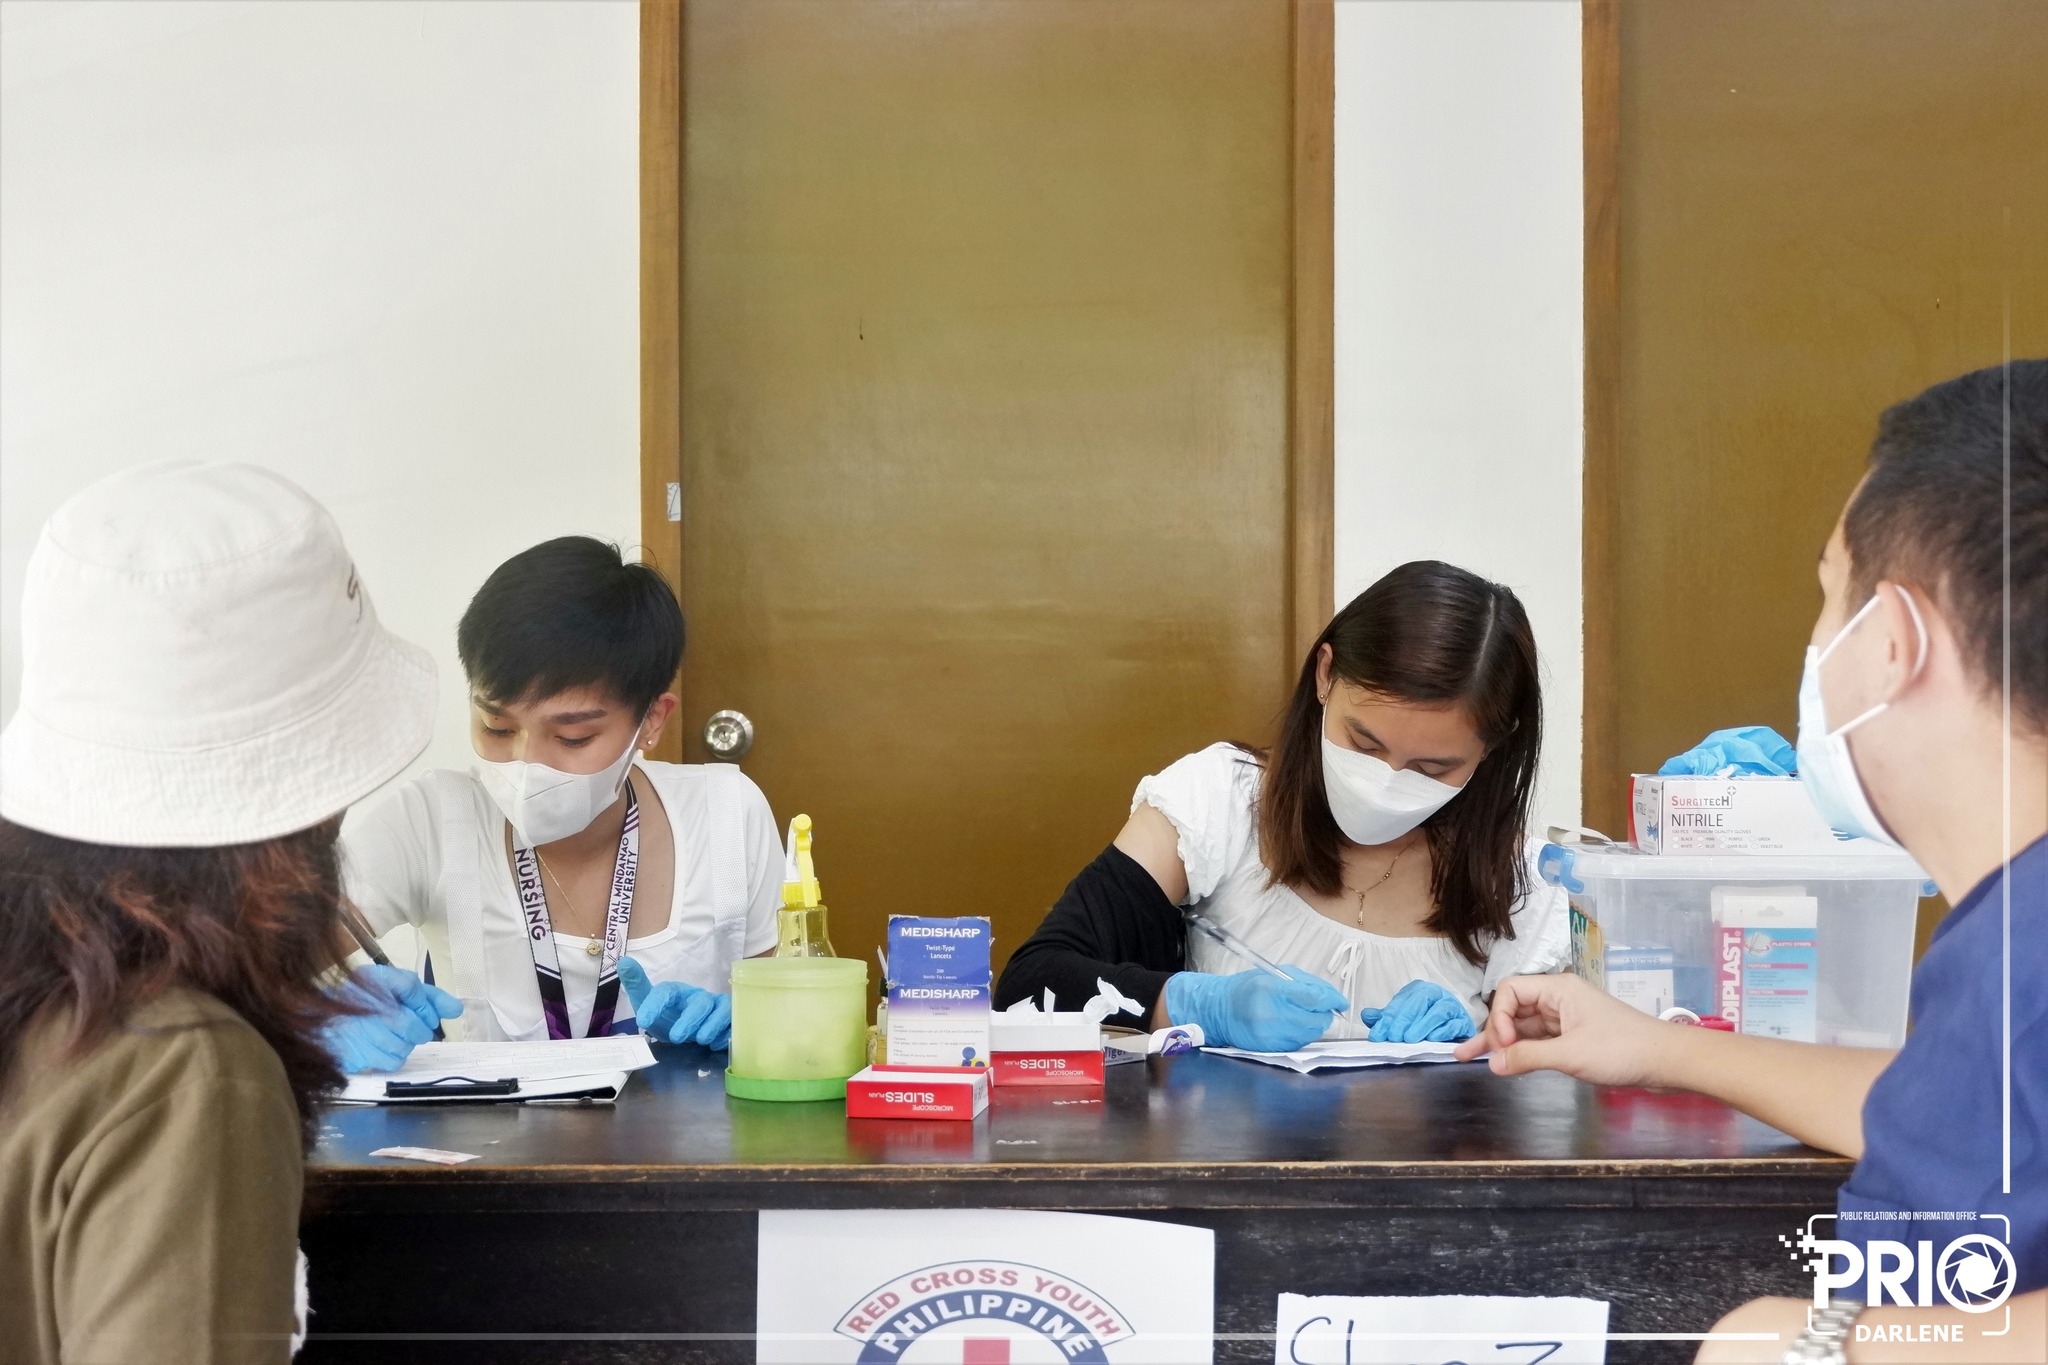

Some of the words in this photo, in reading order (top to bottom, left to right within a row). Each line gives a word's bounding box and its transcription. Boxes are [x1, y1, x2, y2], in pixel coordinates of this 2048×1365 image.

[1671, 795, 1730, 807] SURGITECH
[1671, 813, 1724, 827] NITRILE
[613, 837, 630, 897] MINDANAO
[515, 848, 546, 941] NURSING
[618, 850, 637, 924] UNIVERSITY
[606, 900, 621, 951] CENTRAL
[901, 927, 981, 938] MEDISHARP
[925, 944, 956, 952] Twist-Type
[900, 988, 980, 999] MEDISHARP
[1722, 932, 1742, 1033] DIPLAST
[1020, 1059, 1066, 1069] SLIDES
[885, 1092, 934, 1103] SLIDES
[845, 1290, 902, 1335] RED
[910, 1267, 1019, 1294] CROSS
[1033, 1275, 1121, 1337] YOUTH
[874, 1293, 1094, 1357] PHILIPPINE
